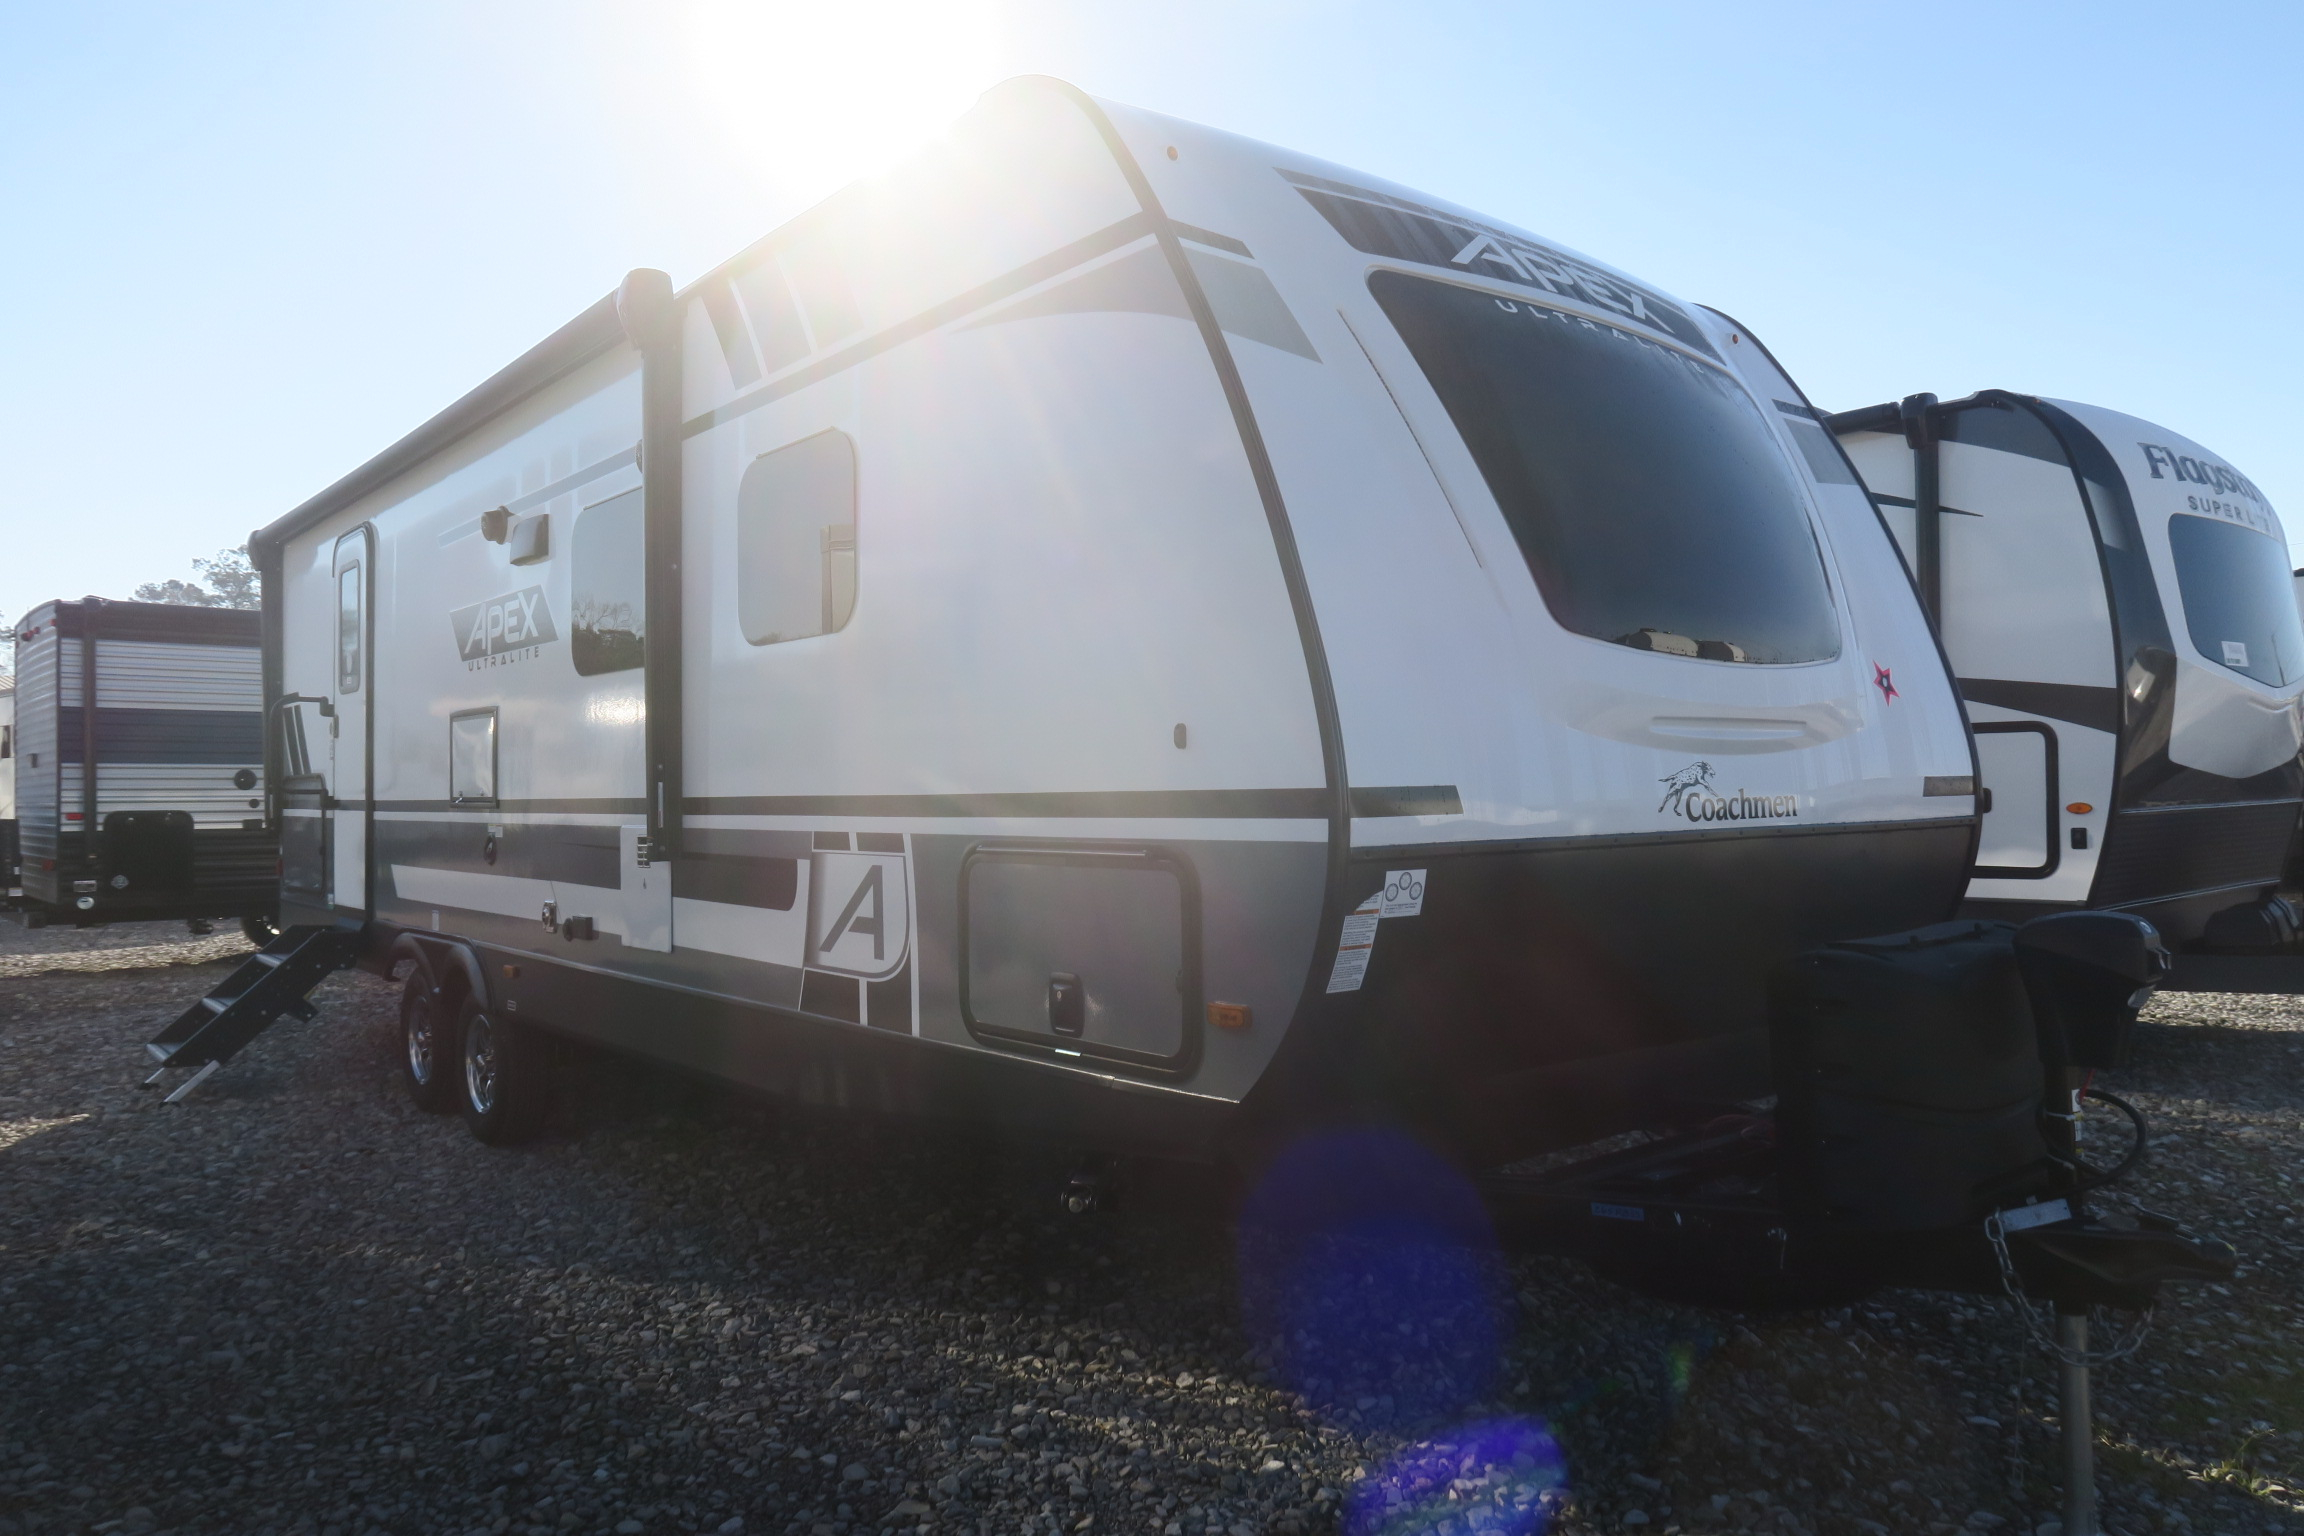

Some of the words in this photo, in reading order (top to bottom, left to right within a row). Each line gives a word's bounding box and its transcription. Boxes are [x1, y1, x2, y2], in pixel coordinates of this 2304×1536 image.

[1451, 233, 1676, 335] APEX
[1495, 299, 1704, 374] ULTRALITE
[2136, 441, 2272, 517] Flagsta
[2187, 495, 2244, 521] SUPER
[464, 591, 539, 656] APEX
[467, 645, 541, 672] ULTRALITE
[1685, 788, 1798, 823] Coachmen
[818, 864, 885, 961] A
